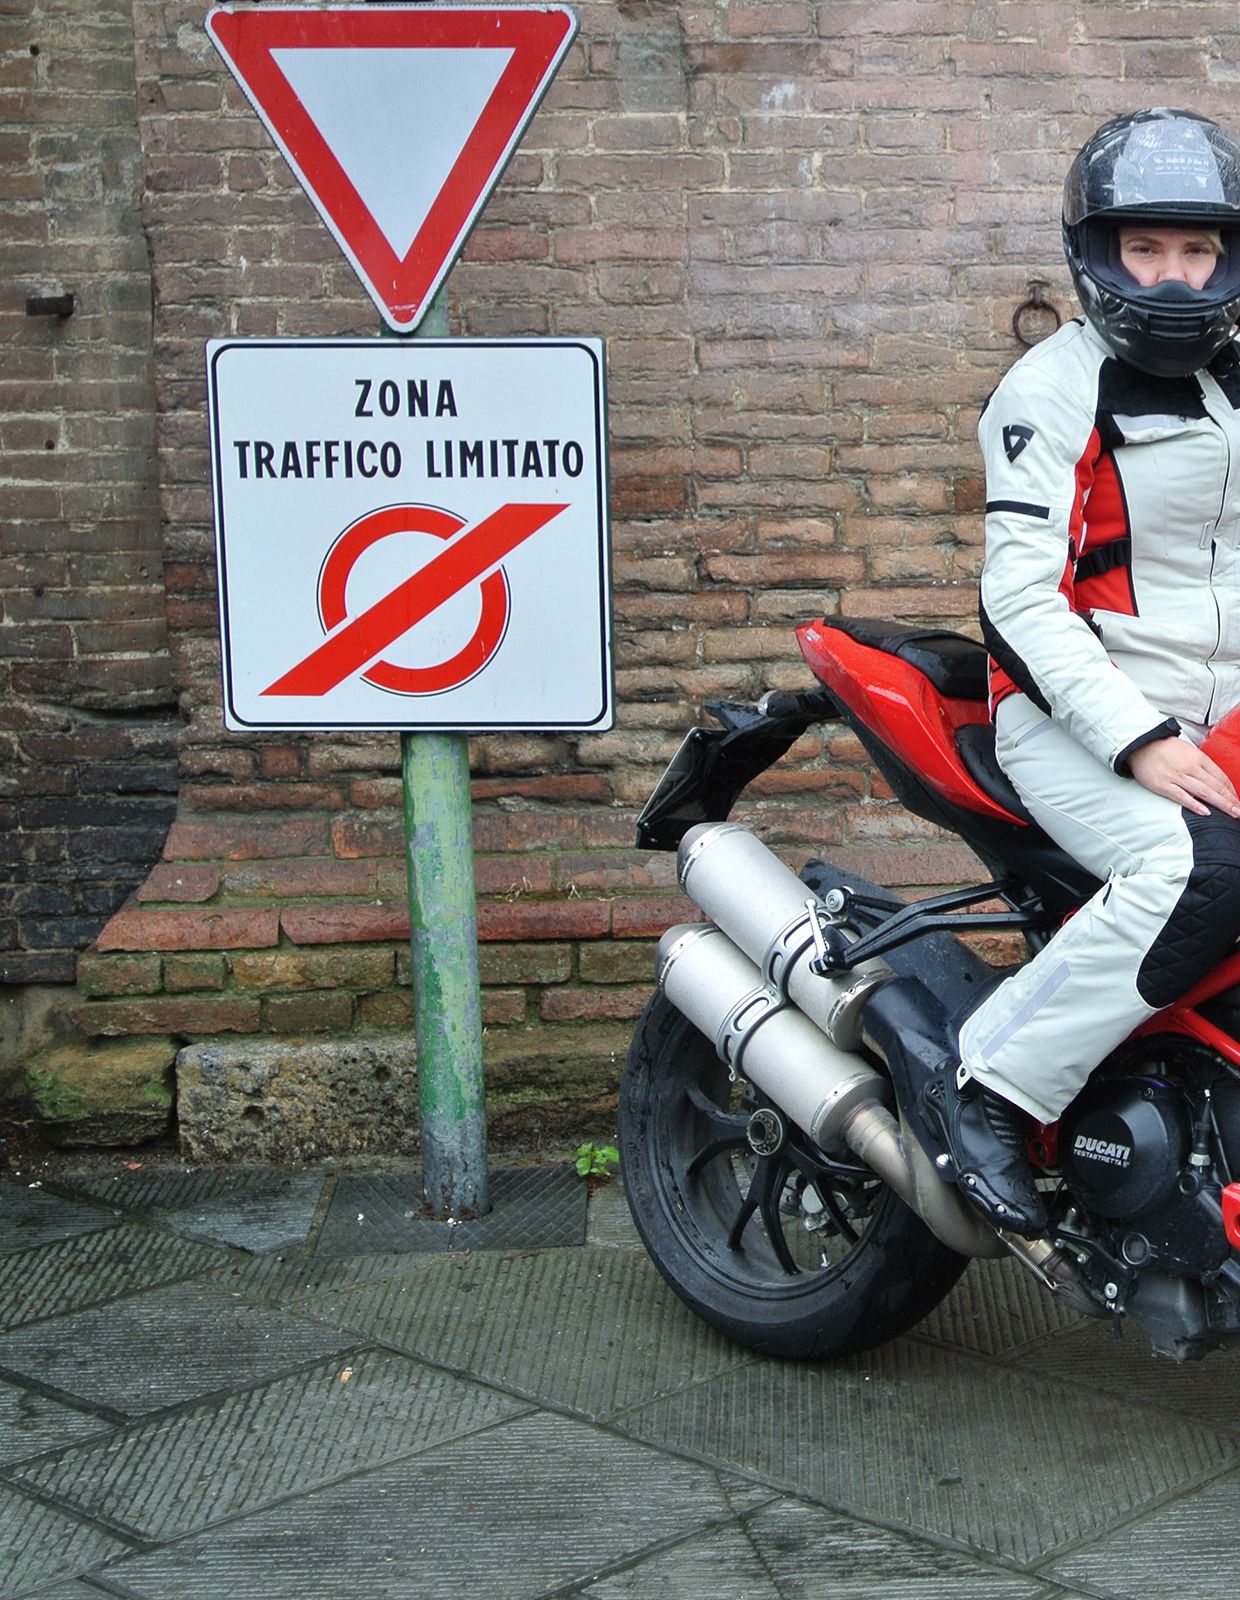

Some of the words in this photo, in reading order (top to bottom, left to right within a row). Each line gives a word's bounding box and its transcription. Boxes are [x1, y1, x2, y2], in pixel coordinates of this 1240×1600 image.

[354, 379, 459, 418] ZONA
[233, 440, 401, 479] TRAFFICO
[426, 439, 584, 478] LIMITATO
[1074, 1135, 1131, 1160] DUCATI
